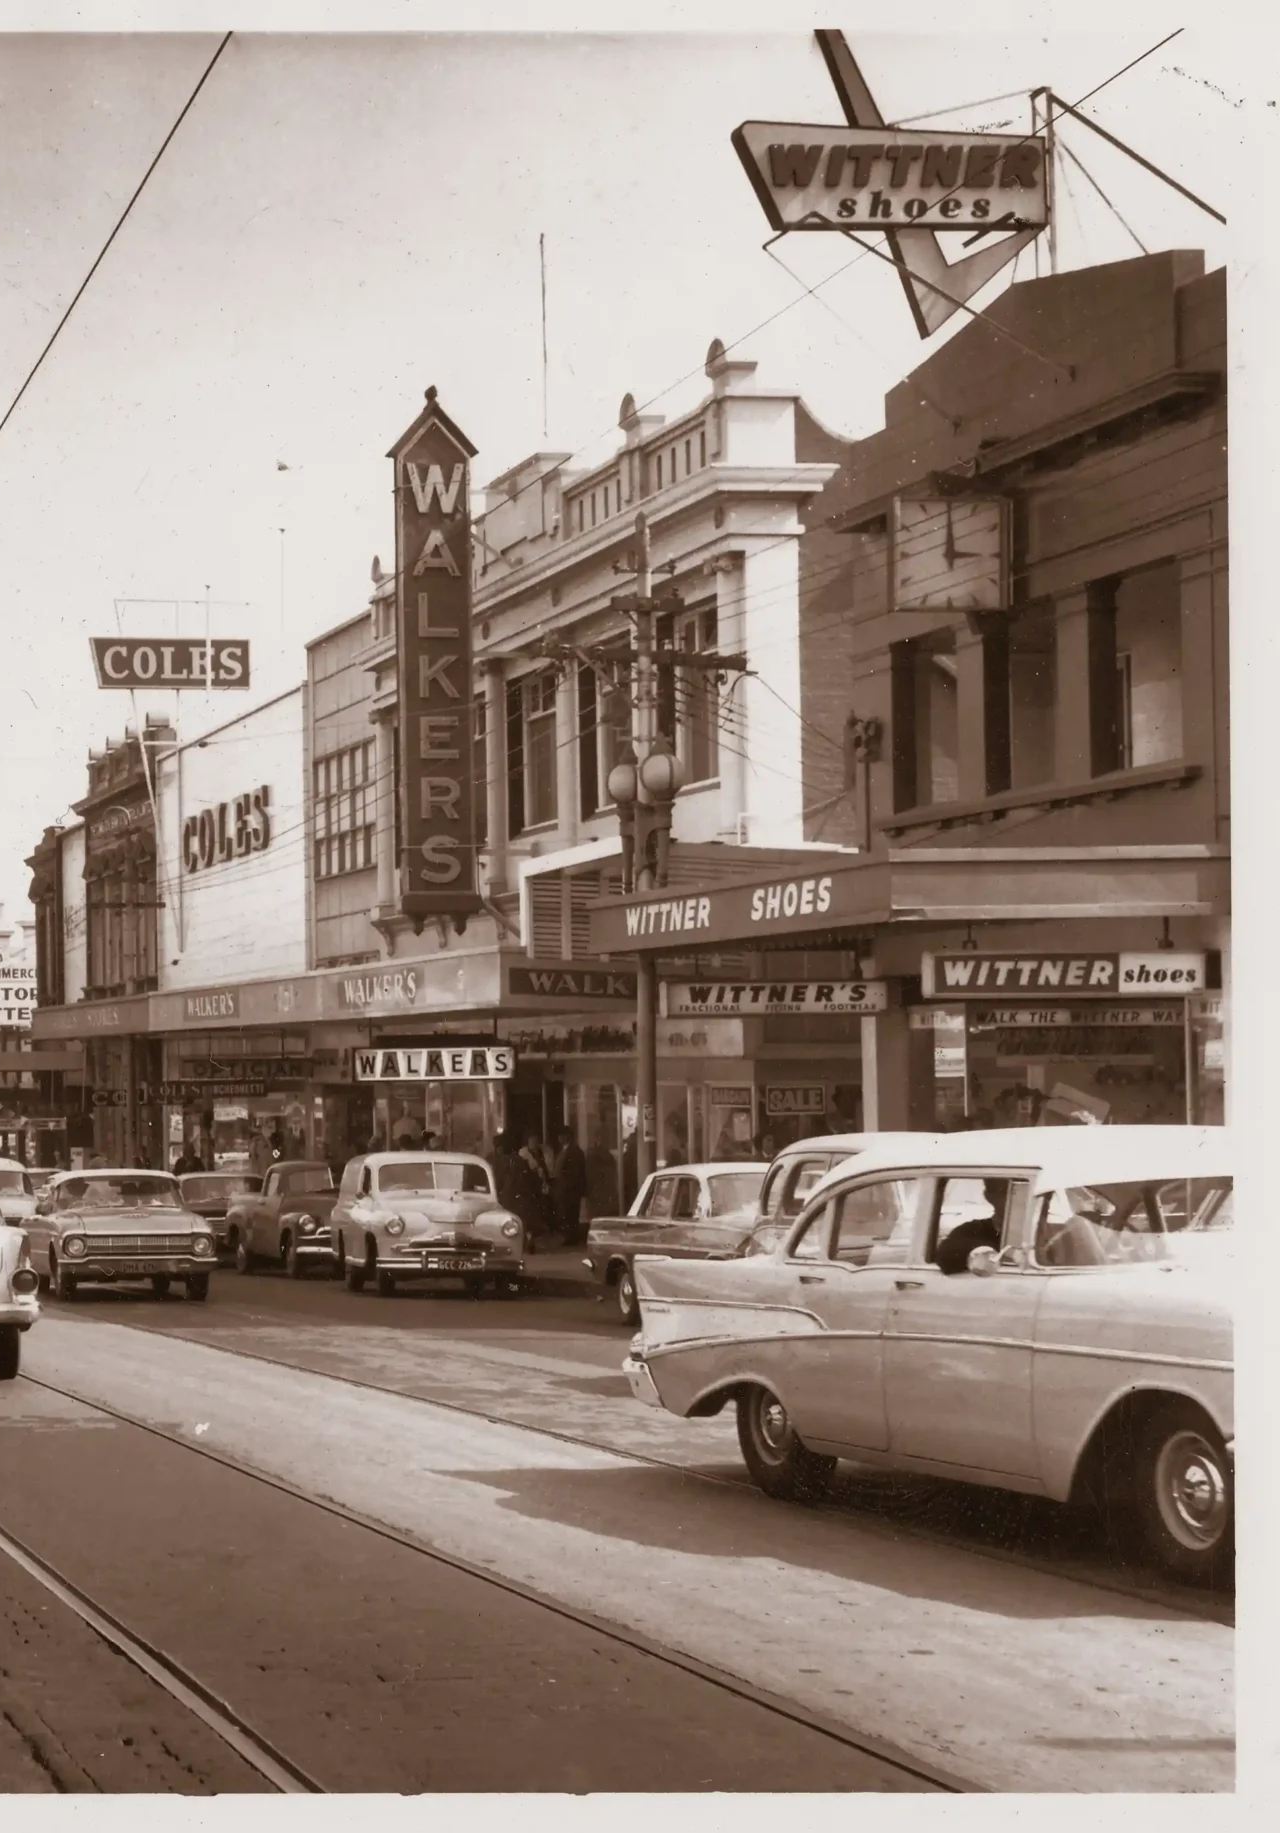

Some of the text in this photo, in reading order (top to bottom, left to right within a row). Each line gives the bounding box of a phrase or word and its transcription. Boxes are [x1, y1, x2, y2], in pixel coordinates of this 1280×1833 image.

[767, 142, 1040, 189] WITTNER
[836, 192, 992, 221] shoes
[104, 645, 243, 681] COLES
[406, 462, 465, 884] WALKERS
[182, 785, 271, 875] COLES
[626, 876, 832, 937] WITTNER SHOES
[943, 959, 1197, 986] WITTNER shoes
[344, 972, 417, 1003] WALKER'S
[688, 984, 868, 1003] WITTNER'S
[187, 991, 235, 1017] WALKER'S
[976, 1011, 1018, 1024] WALK
[1029, 1011, 1057, 1023] THE
[358, 1050, 510, 1077] WALKER'S
[771, 1087, 821, 1110] SALE
